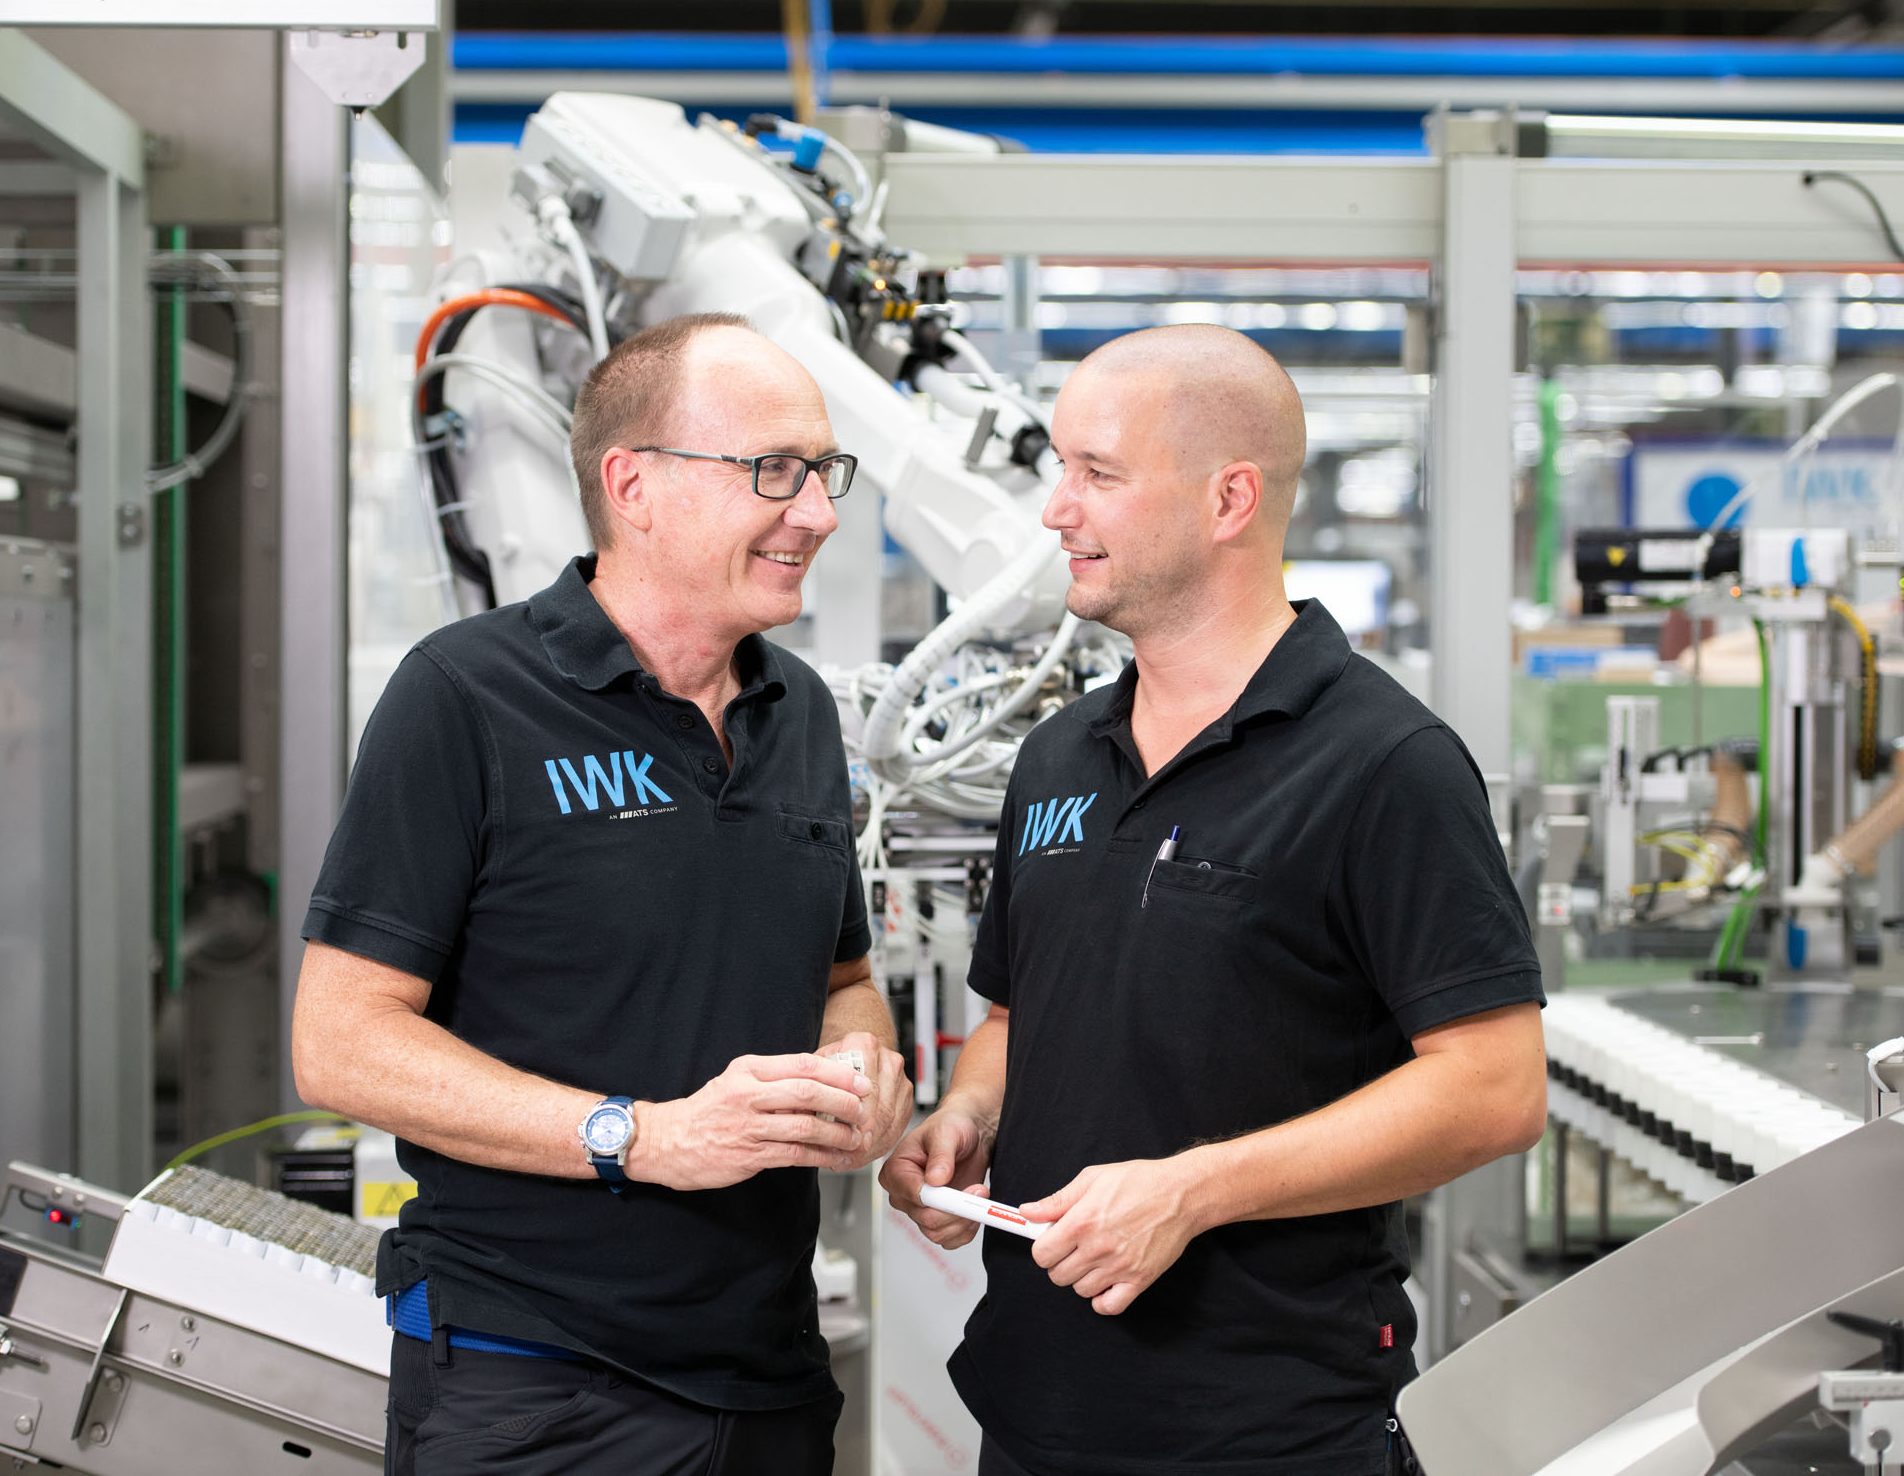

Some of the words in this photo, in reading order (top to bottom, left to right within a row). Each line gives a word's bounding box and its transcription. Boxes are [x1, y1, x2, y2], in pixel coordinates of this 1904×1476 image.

[544, 750, 674, 815] IWK
[650, 806, 678, 814] COMPANY
[1018, 792, 1098, 857] IWK
